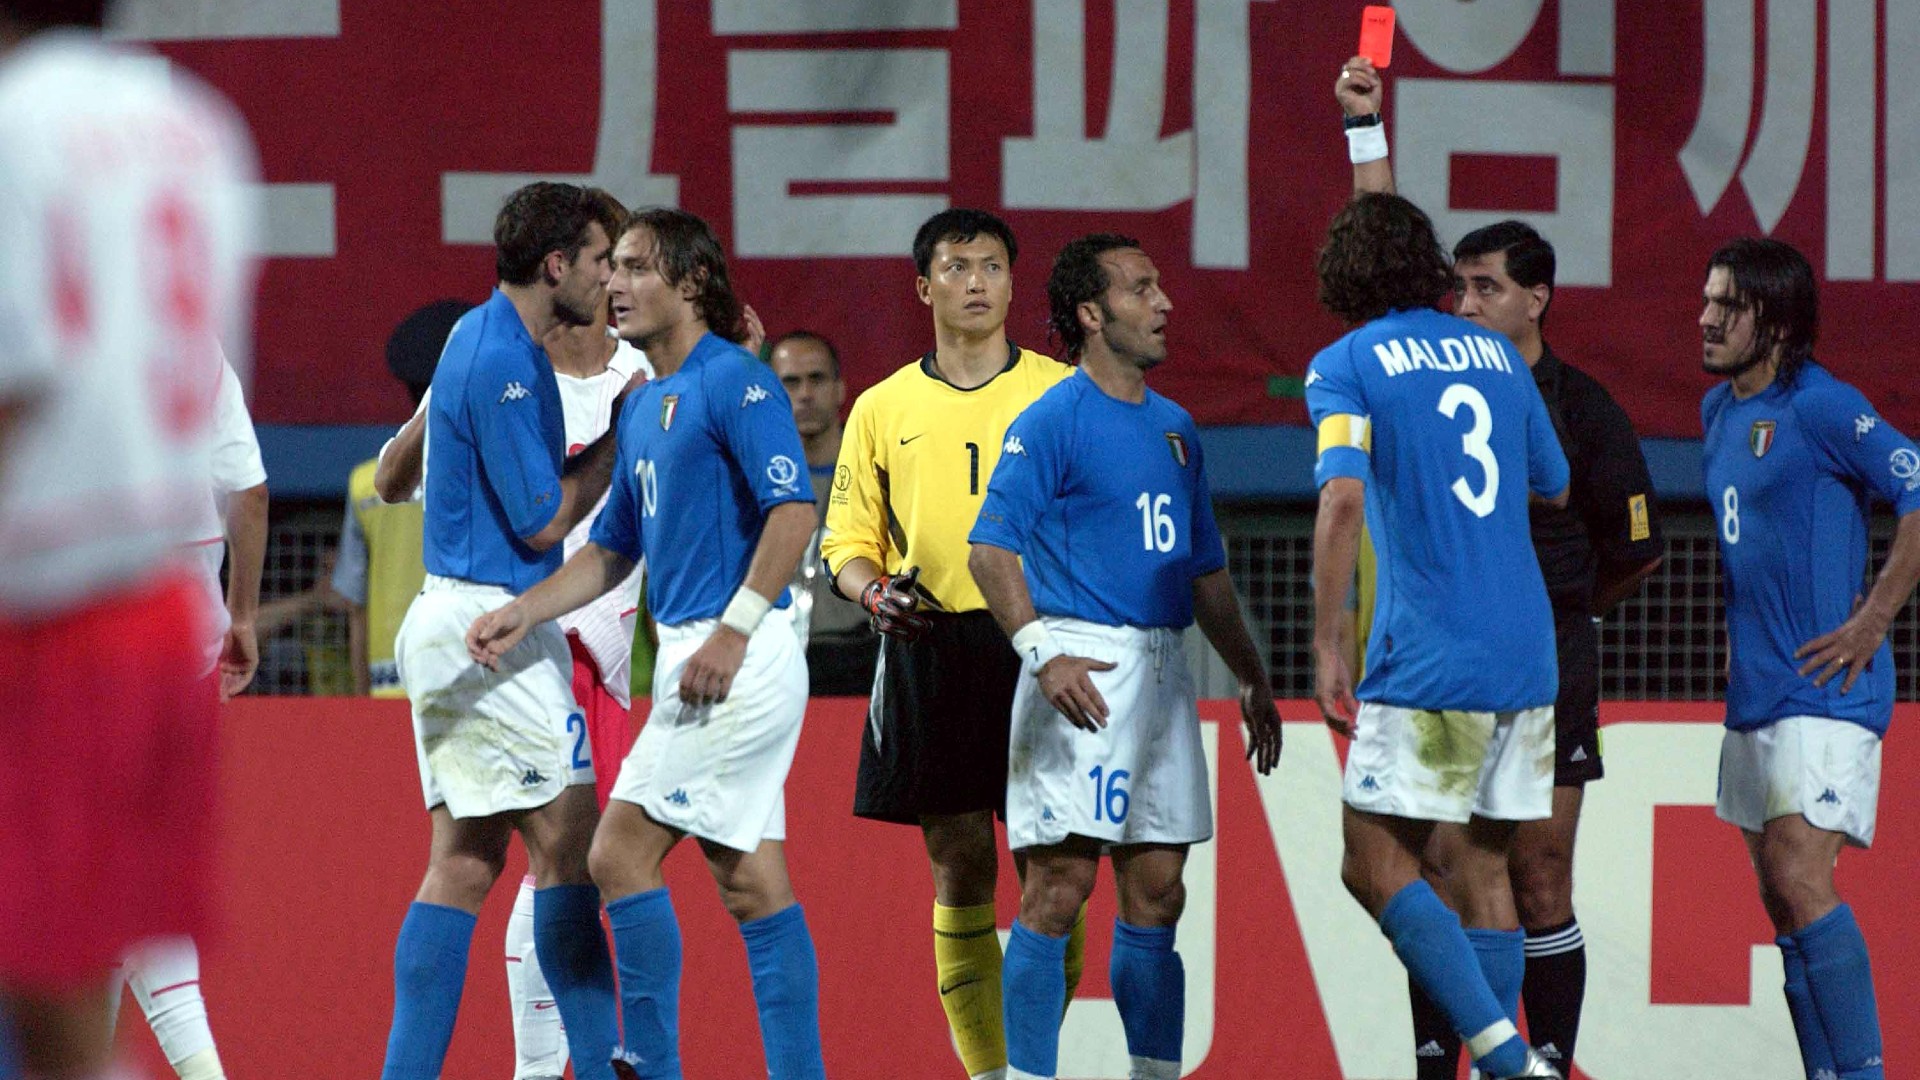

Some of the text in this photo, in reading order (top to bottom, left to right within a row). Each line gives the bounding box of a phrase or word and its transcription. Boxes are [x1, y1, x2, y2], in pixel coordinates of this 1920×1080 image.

[1373, 335, 1512, 377] MALDINI
[965, 442, 979, 495] 1
[1437, 383, 1500, 518] 3
[1136, 492, 1176, 553] 16
[1723, 485, 1740, 545] 8
[1088, 765, 1131, 825] 16
